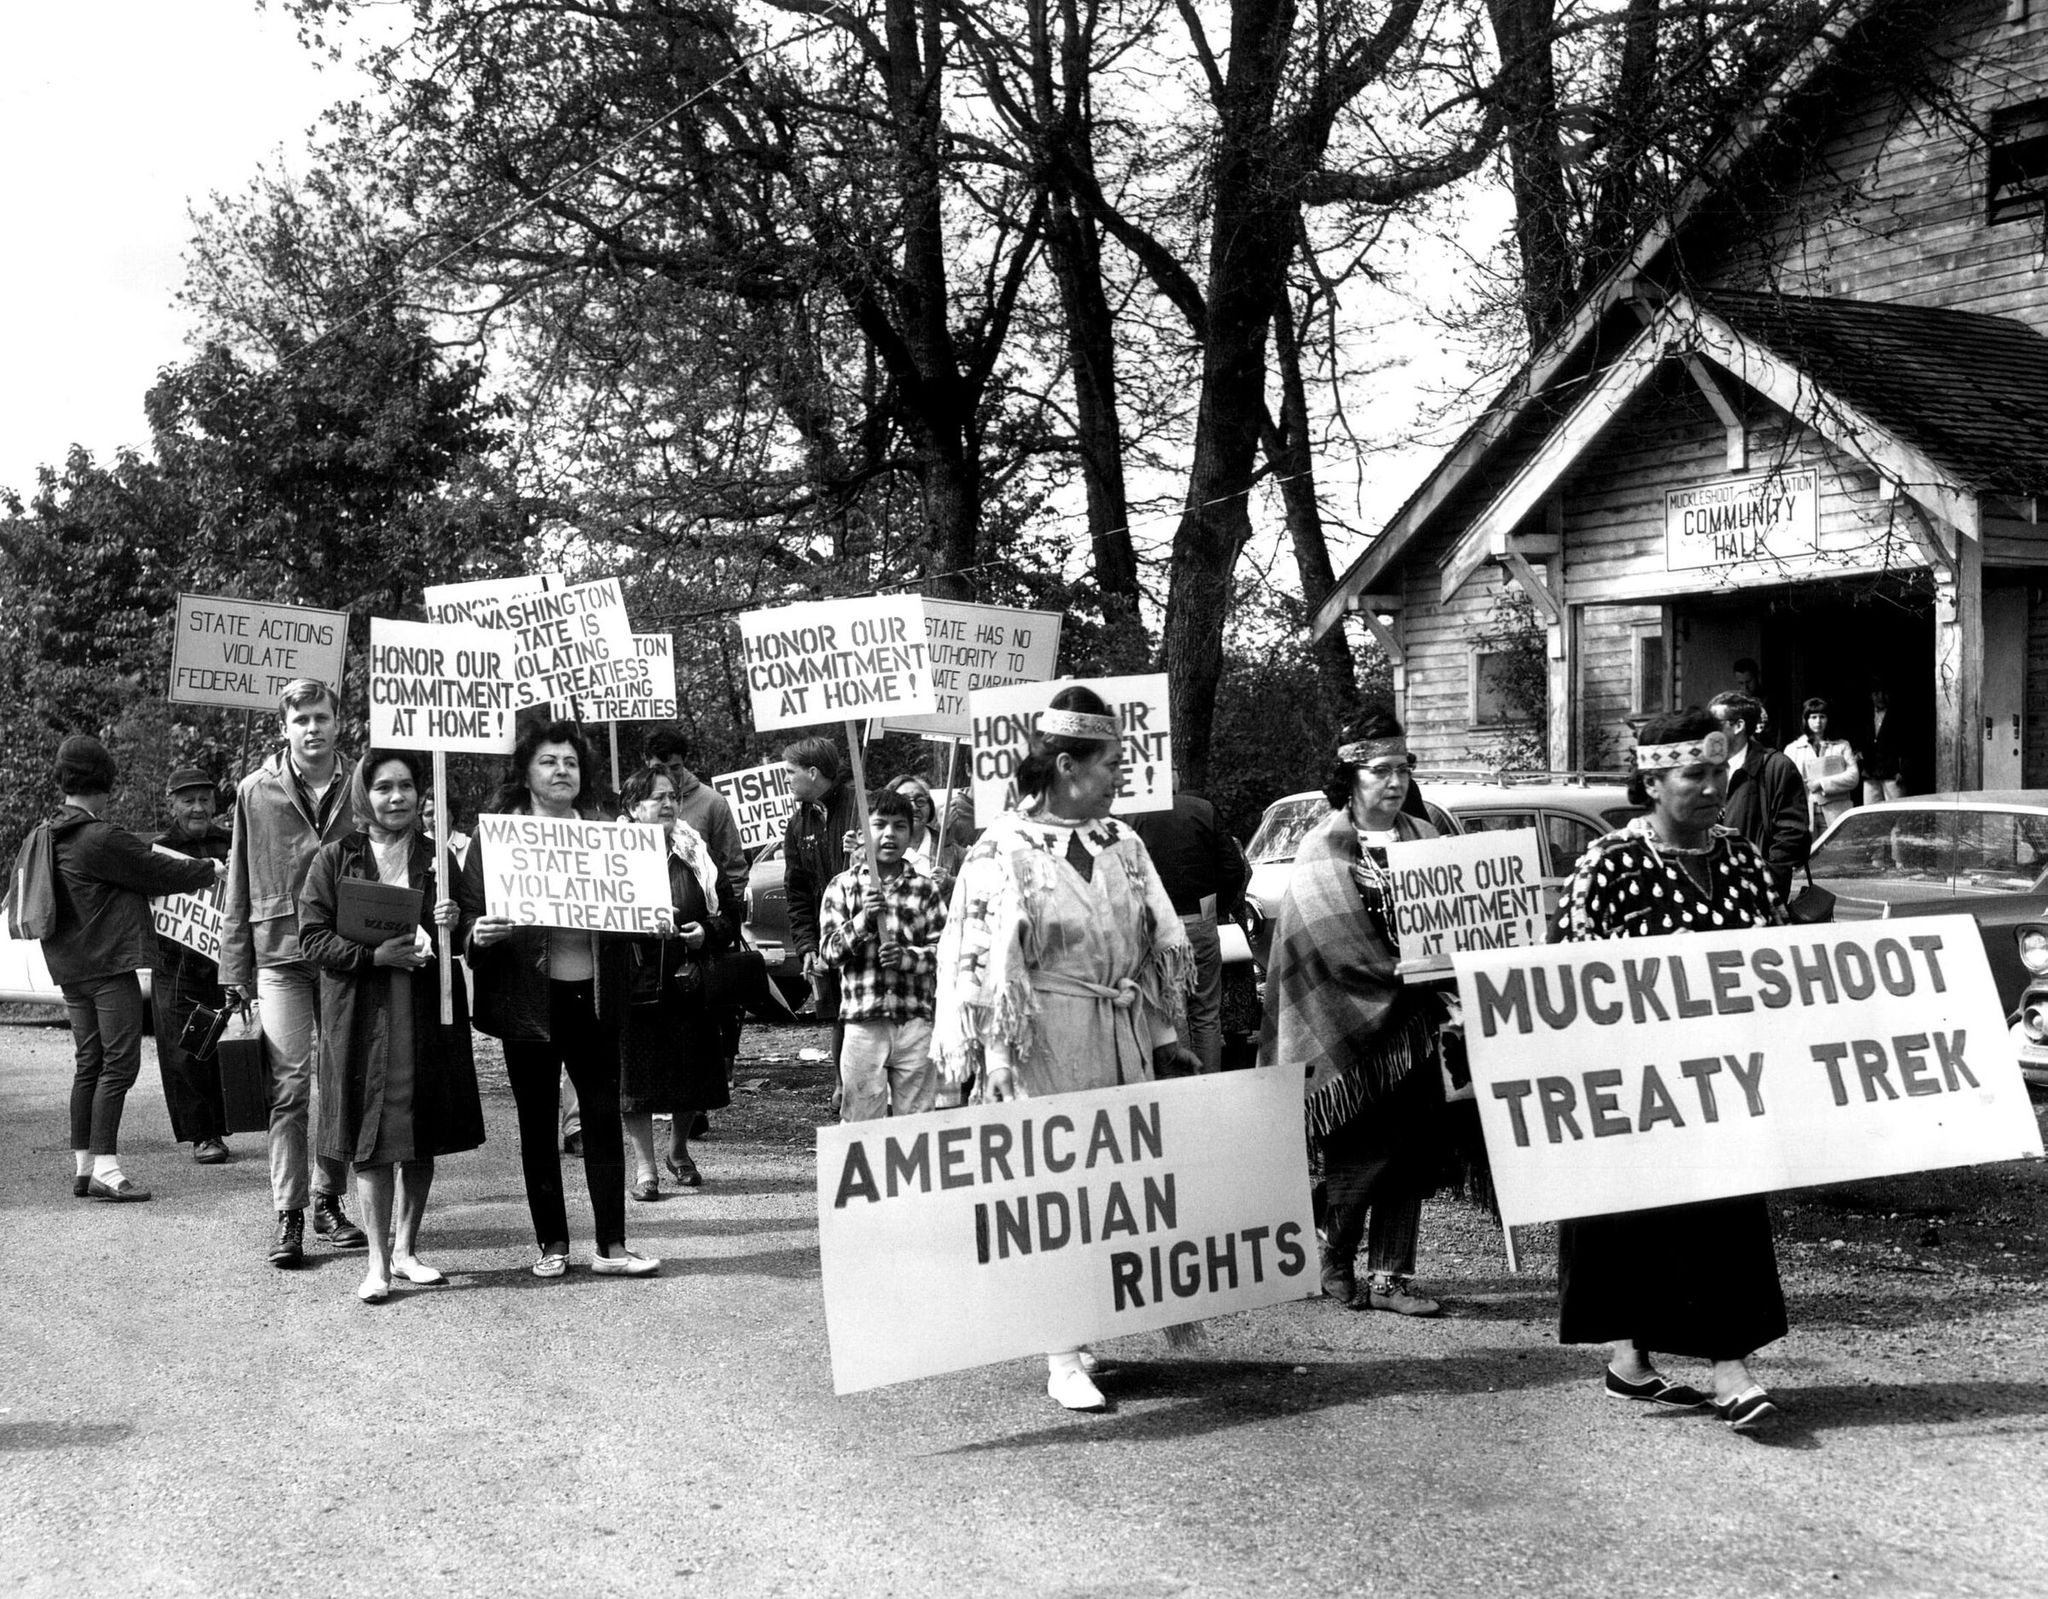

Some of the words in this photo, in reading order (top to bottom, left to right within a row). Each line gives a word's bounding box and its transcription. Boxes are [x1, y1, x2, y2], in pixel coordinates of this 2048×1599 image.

[1670, 486, 1735, 510] MUCKLESHOOT
[1684, 495, 1796, 536] COMMUNITY
[1714, 531, 1765, 561] HALL
[189, 610, 251, 637] STATE
[258, 618, 334, 646] ACTIONS
[515, 618, 573, 656] TATE
[580, 612, 600, 638] IS
[744, 624, 838, 664] HONOR
[851, 616, 907, 647] OUR
[924, 617, 967, 642] STATE
[976, 624, 1005, 646] HAS
[1012, 628, 1032, 649] NO
[223, 641, 299, 670] VIOLATE
[372, 645, 445, 678] HONOR
[456, 650, 503, 681] OUR
[515, 637, 610, 681] IOLATING
[749, 643, 926, 692] COMMITMENT
[1007, 652, 1025, 673] TO
[177, 667, 260, 694] FEDERAL
[373, 676, 514, 710] COMMITMENT
[593, 698, 677, 720] TREATIES
[780, 686, 809, 718] AT
[392, 708, 417, 737] AT
[973, 711, 1045, 749] HON
[481, 820, 657, 852] WASHINGTON
[767, 821, 777, 839] A
[511, 848, 591, 876] STATE
[604, 853, 628, 877] IS
[1391, 863, 1465, 903] HONOR
[1474, 855, 1525, 890] OUR
[500, 874, 636, 904] VIOLATING
[549, 902, 672, 931] TREATIES
[1397, 884, 1541, 936] COMMITMENT
[182, 924, 193, 946] A
[1423, 933, 1444, 956] AT
[1474, 934, 1947, 1037] MUCKLESHOOT
[1491, 1051, 1765, 1148] TREATY
[1809, 1029, 1981, 1107] TREK
[834, 1101, 1163, 1209] AMERICAN
[974, 1172, 1178, 1265] INDIAN
[1110, 1221, 1307, 1312] RIGHTS
